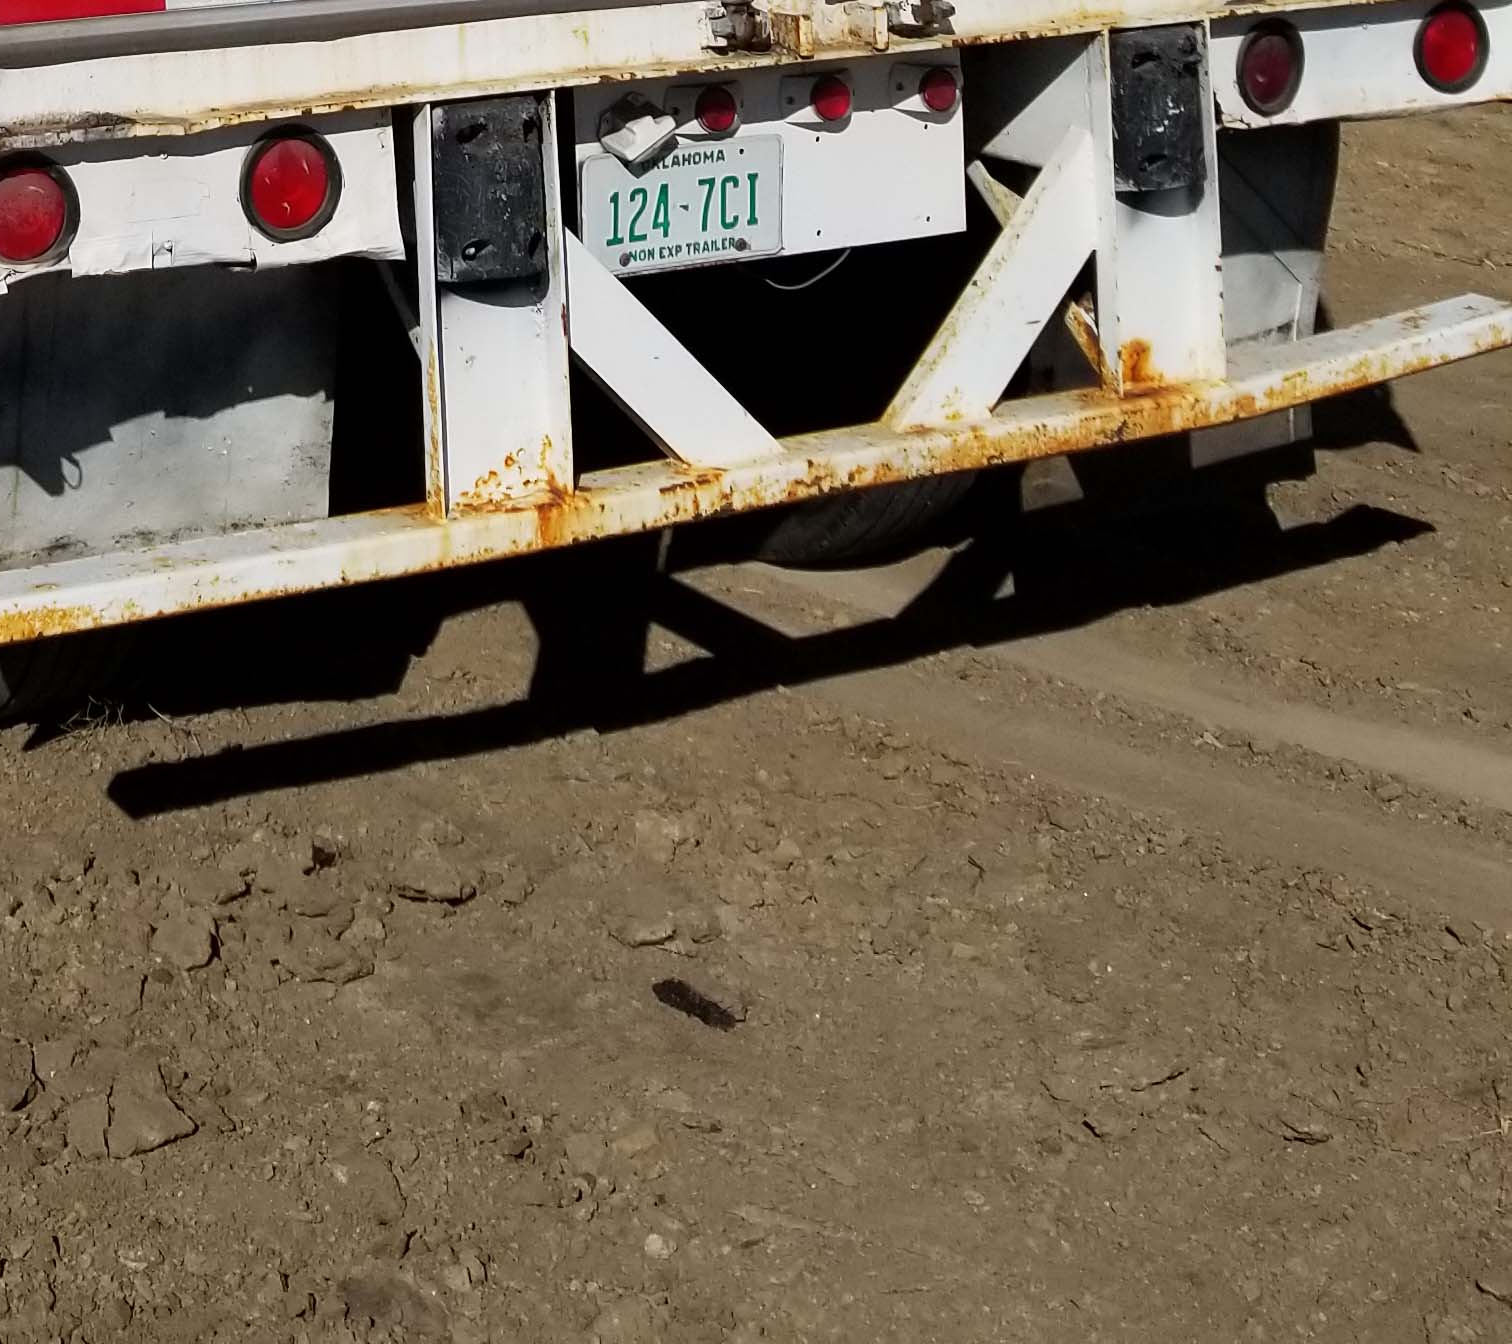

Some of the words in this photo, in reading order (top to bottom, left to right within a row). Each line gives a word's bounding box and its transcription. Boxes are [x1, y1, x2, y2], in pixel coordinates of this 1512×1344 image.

[628, 248, 655, 263] NON
[659, 244, 683, 259] EXP
[686, 237, 736, 256] TRAILER
